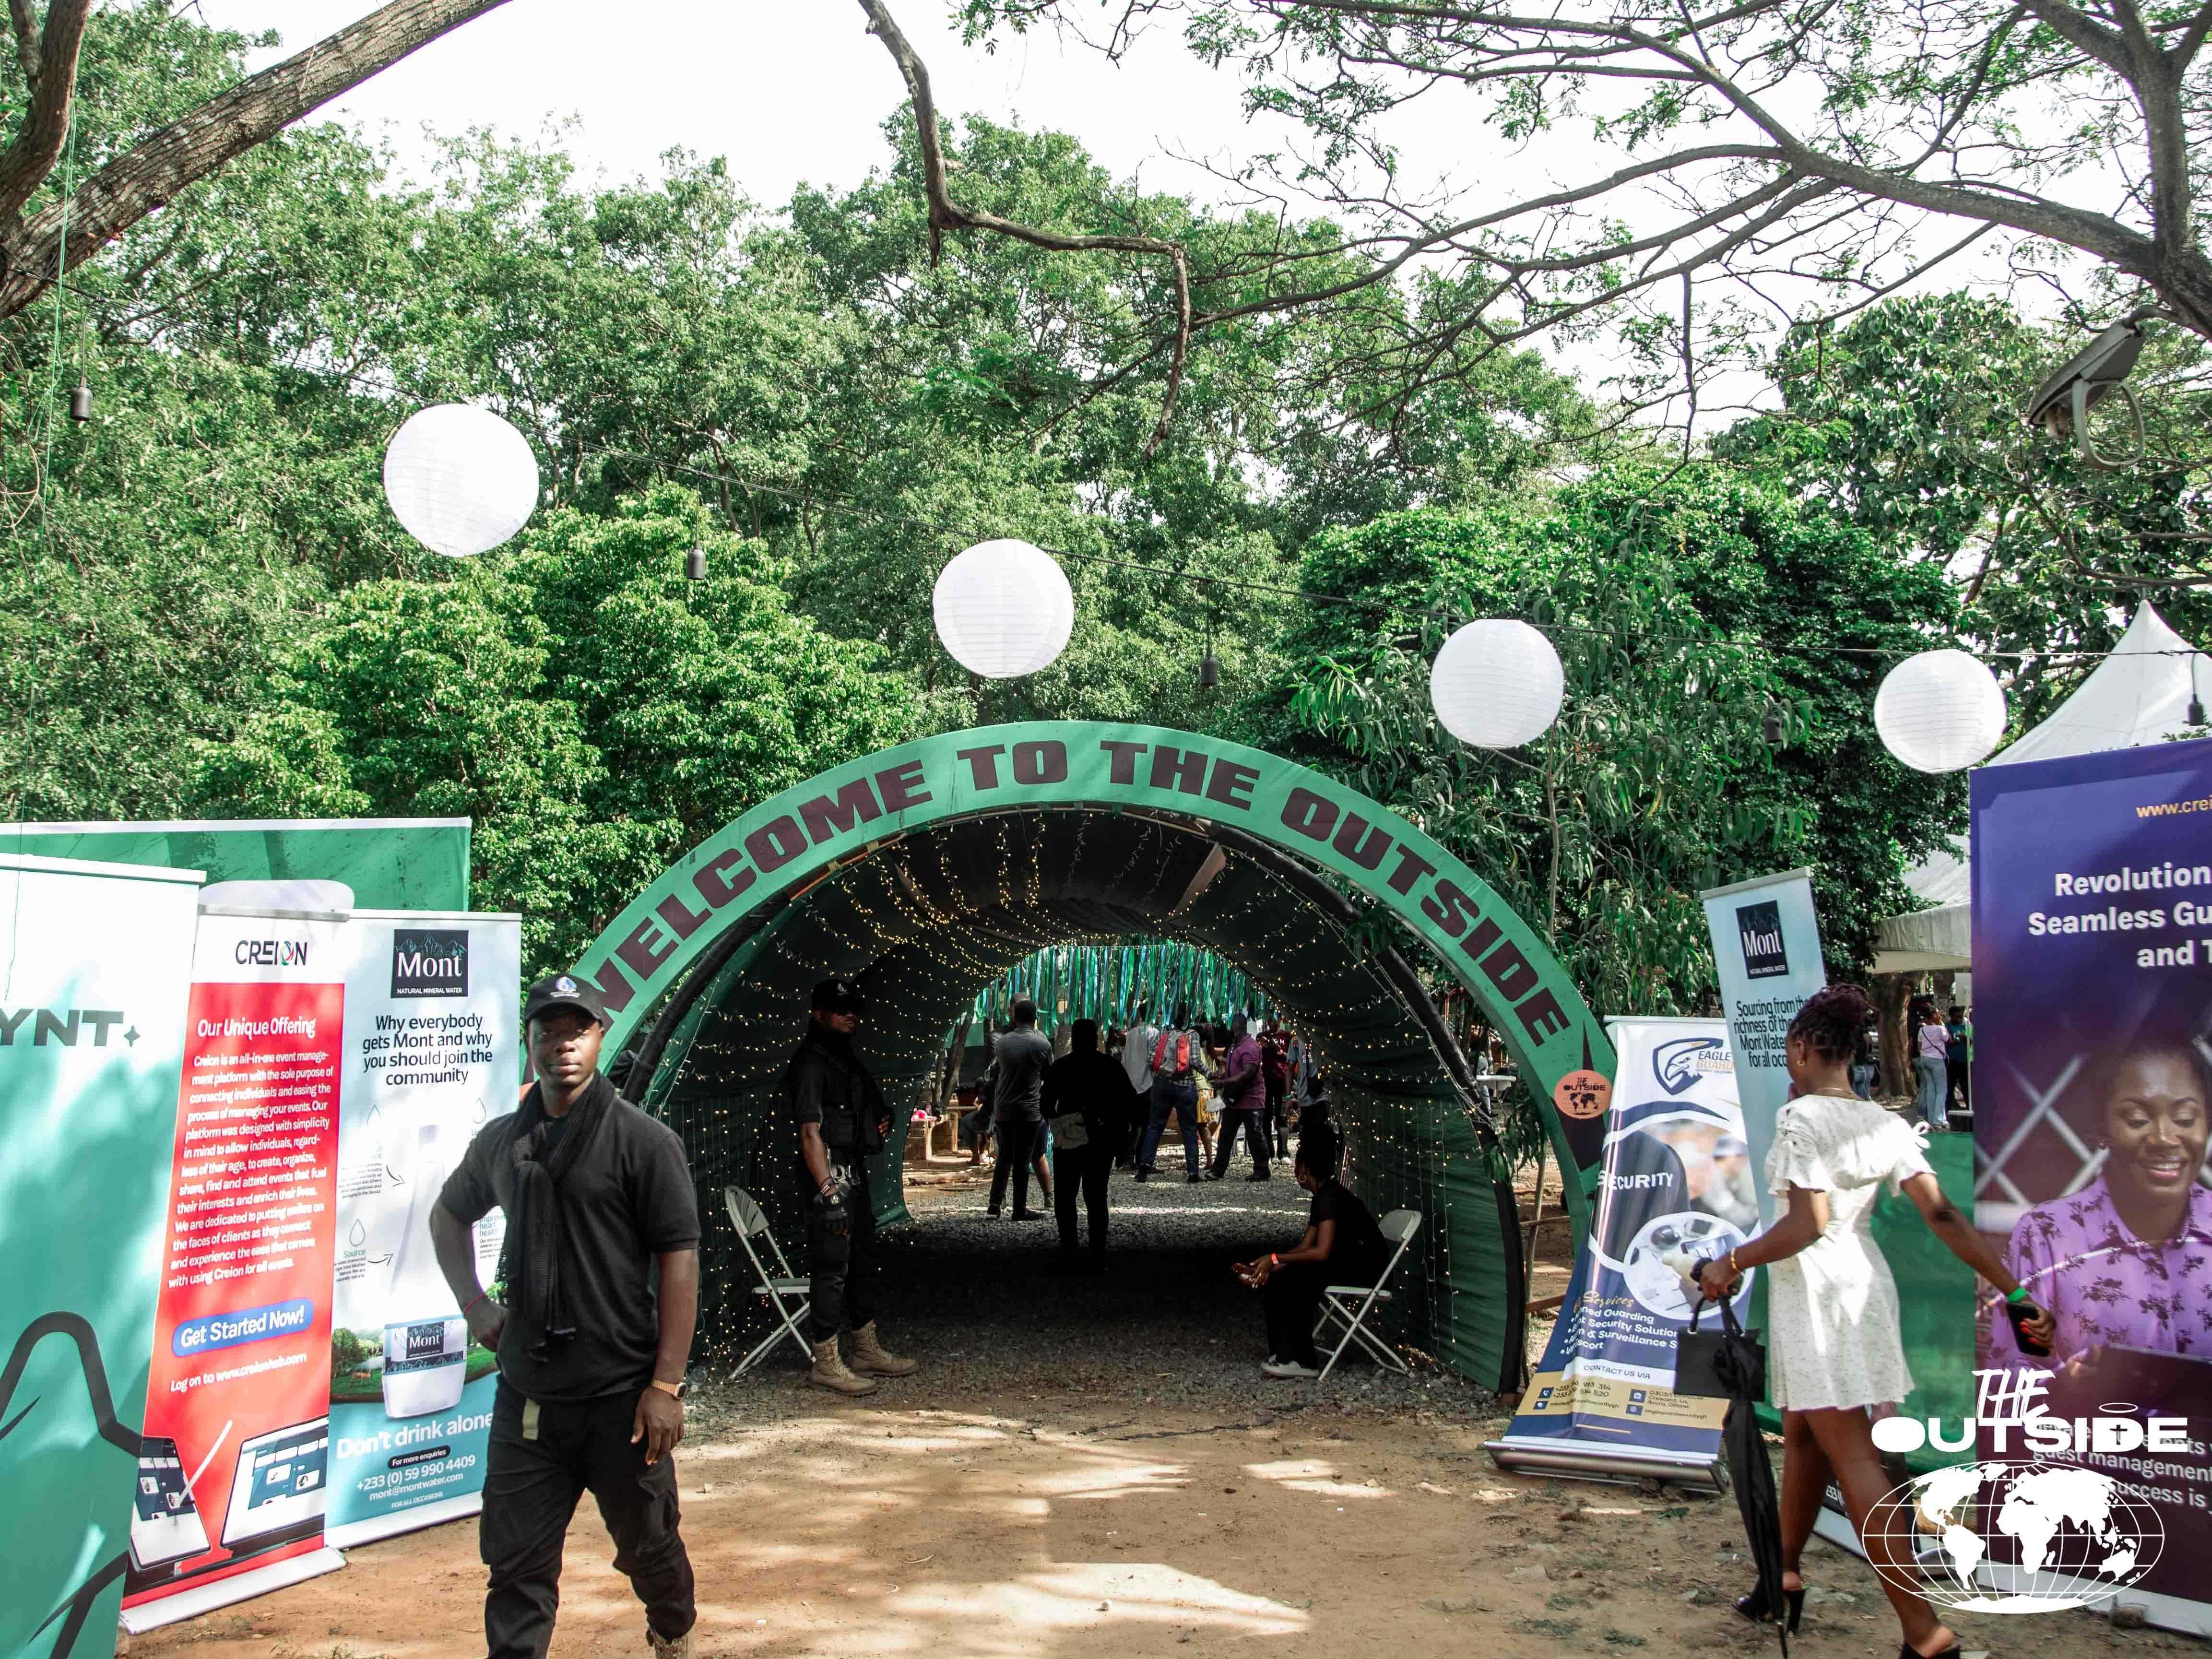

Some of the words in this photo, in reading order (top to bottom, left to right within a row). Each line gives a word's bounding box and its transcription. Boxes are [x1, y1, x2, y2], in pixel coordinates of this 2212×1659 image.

[2054, 862, 2211, 896] Revolution
[957, 740, 1068, 791] TO
[1100, 740, 1260, 811] THE
[1280, 787, 1570, 1048] OUTSIDE
[2028, 906, 2166, 936] Seamless
[236, 940, 308, 966] CREION
[1742, 929, 1782, 957] Mont
[2136, 940, 2195, 968] and
[397, 952, 463, 978] Mont
[1736, 998, 1774, 1019] Sourcing
[1773, 997, 1796, 1014] from
[198, 1019, 222, 1037] Our
[223, 1017, 269, 1040] Unique
[270, 1016, 316, 1039] Offering
[376, 1015, 405, 1034] Why
[409, 1013, 483, 1031] everybody
[1734, 1017, 1767, 1034] richness
[1768, 1015, 1778, 1032] of
[363, 1035, 390, 1054] gets
[393, 1033, 434, 1048] Mont
[437, 1031, 462, 1046] and
[466, 1031, 492, 1048] why
[1739, 1034, 1763, 1051] Mont
[239, 1053, 275, 1064] all-in-one
[275, 1053, 296, 1062] event
[296, 1051, 330, 1064] manage-
[364, 1056, 386, 1073] you
[390, 1051, 441, 1067] should
[444, 1050, 468, 1068] join
[471, 1048, 493, 1063] the
[1698, 1051, 1733, 1061] EAGLE
[1749, 1051, 1761, 1067] for
[267, 1069, 279, 1079] the
[280, 1068, 295, 1079] sole
[296, 1069, 325, 1081] purpose
[325, 1066, 334, 1077] of
[386, 1068, 468, 1086] community
[278, 1085, 292, 1096] and
[293, 1084, 317, 1097] easing
[318, 1083, 331, 1093] the
[269, 1104, 287, 1118] your
[287, 1102, 311, 1112] events.
[312, 1101, 328, 1111] Our
[185, 1127, 221, 1144] platform
[222, 1126, 238, 1136] was
[239, 1121, 274, 1137] designed
[275, 1120, 292, 1131] with
[293, 1116, 330, 1132] simplicity
[184, 1147, 192, 1159] in
[193, 1144, 216, 1158] mind
[225, 1141, 248, 1154] allow
[249, 1137, 292, 1151] individuals,
[293, 1134, 321, 1149] regard-
[228, 1161, 247, 1174] age,
[248, 1159, 257, 1170] to
[257, 1156, 282, 1169] create,
[283, 1152, 317, 1168] organize,
[206, 1178, 223, 1193] find
[223, 1177, 241, 1191] and
[242, 1173, 268, 1188] attend
[268, 1172, 294, 1185] events
[1597, 1170, 1673, 1190] SECURITY
[177, 1200, 199, 1215] their
[198, 1197, 235, 1211] interests
[236, 1193, 253, 1206] and
[253, 1189, 278, 1204] enrich
[175, 1221, 189, 1232] We
[189, 1219, 203, 1231] are
[205, 1211, 247, 1230] dedicated
[248, 1210, 257, 1222] to
[173, 1240, 187, 1252] the
[189, 1236, 211, 1249] faces
[211, 1232, 221, 1244] of
[221, 1228, 251, 1243] clients
[251, 1228, 261, 1238] as
[170, 1256, 189, 1270] and
[189, 1249, 236, 1269] experience
[237, 1247, 250, 1259] the
[168, 1274, 188, 1289] with
[190, 1269, 214, 1285] using
[214, 1266, 244, 1280] Creion
[245, 1263, 256, 1275] for
[1584, 1291, 1635, 1308] Services
[181, 1326, 207, 1348] Get
[210, 1312, 268, 1341] Started
[269, 1304, 305, 1330] Now!
[1588, 1319, 1632, 1332] Security
[1604, 1309, 1655, 1326] Guarding
[410, 1335, 440, 1349] Mont
[1598, 1331, 1666, 1347] Surveillance
[1669, 1340, 1678, 1349] S
[1584, 1364, 1622, 1375] CONTACT
[170, 1379, 189, 1393] Log
[189, 1376, 201, 1387] on
[202, 1373, 215, 1385] to
[337, 1430, 391, 1459] Don't
[395, 1421, 443, 1446] drink
[447, 1412, 493, 1435] alone
[392, 1458, 403, 1467] For
[403, 1454, 420, 1464] more
[420, 1449, 446, 1460] enquiries
[357, 1475, 385, 1491] +233
[387, 1470, 403, 1487] (0)
[405, 1467, 419, 1481] 59
[421, 1462, 444, 1477] 990
[445, 1454, 476, 1471] 4409
[369, 1473, 463, 1501] mont@montwater.com
[414, 1492, 444, 1504] OCCASIONS
[2117, 1480, 2183, 1504] uccess
[2188, 1488, 2207, 1508] is
